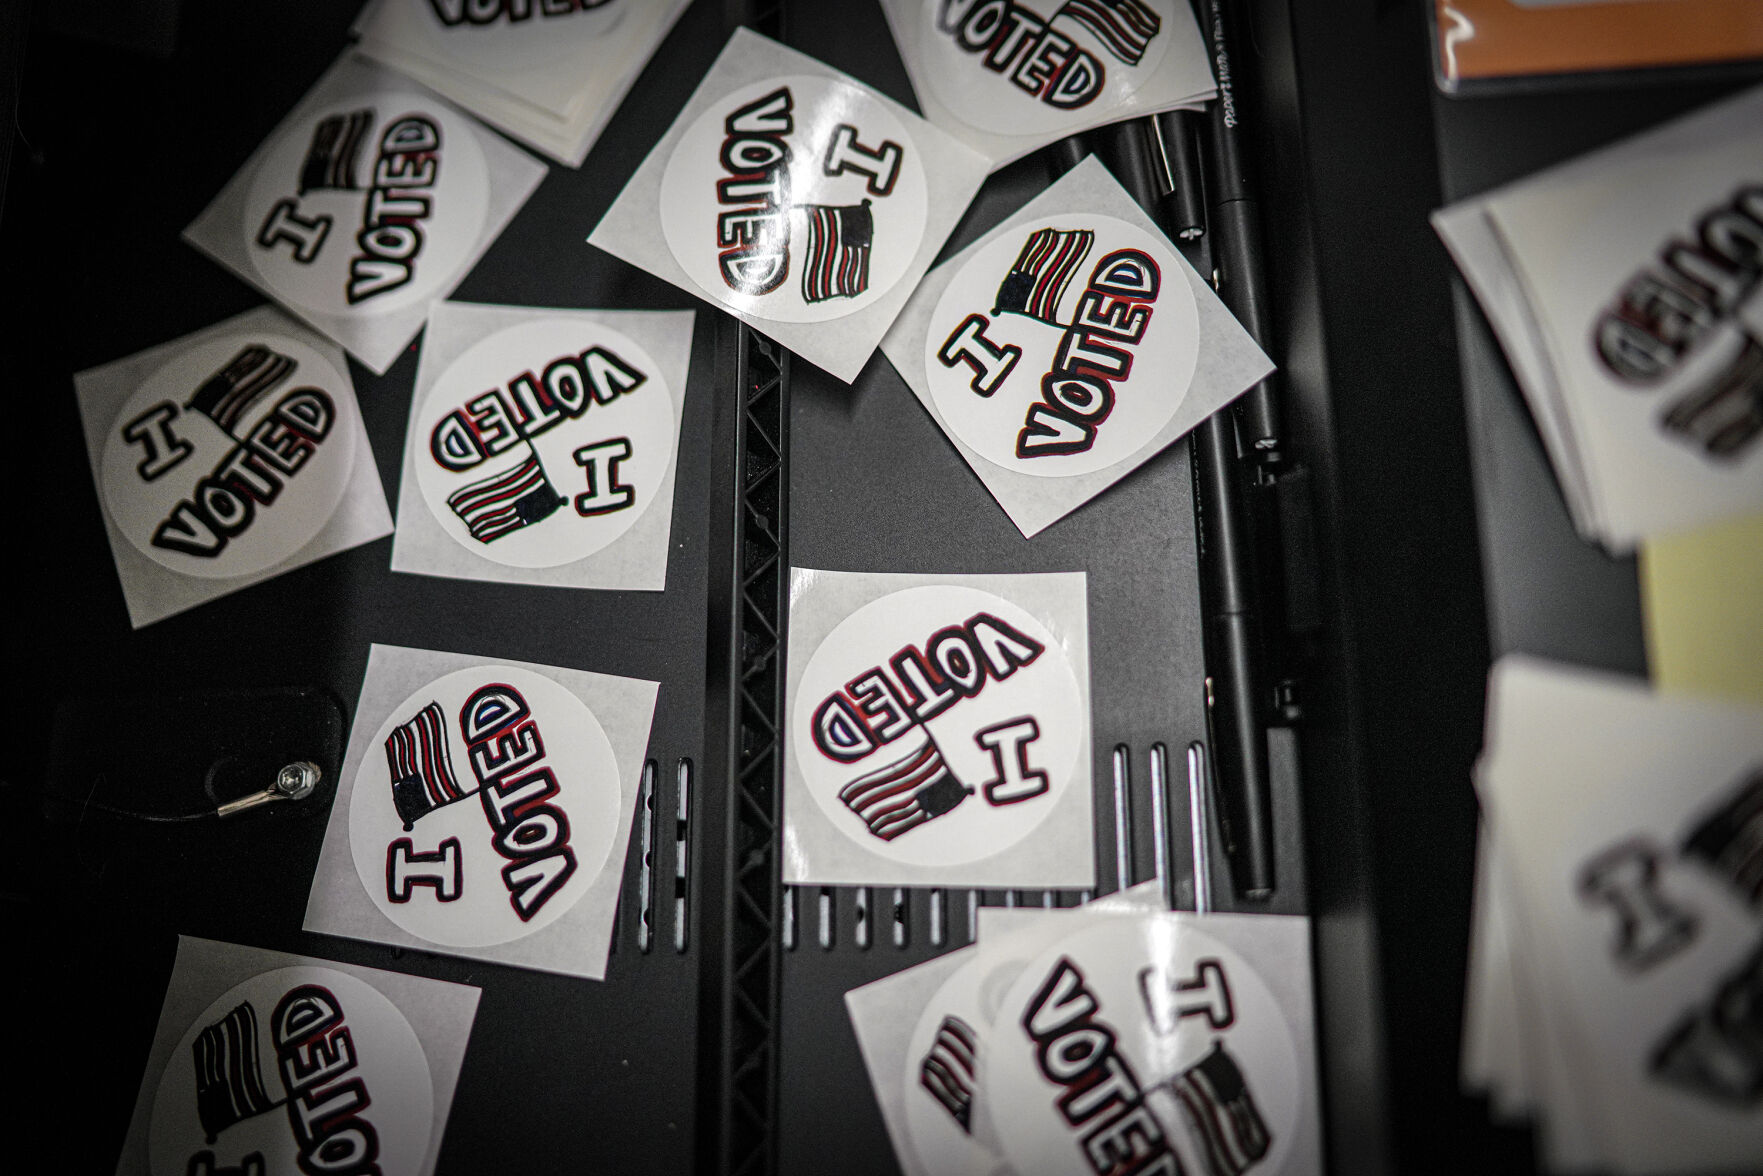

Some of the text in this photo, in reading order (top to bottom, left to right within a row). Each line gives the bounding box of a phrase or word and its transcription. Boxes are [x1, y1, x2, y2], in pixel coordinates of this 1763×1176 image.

[346, 114, 442, 305] VOTED
[716, 87, 793, 297] VOTED
[824, 124, 902, 197] I
[256, 198, 332, 264] I
[937, 313, 1022, 398] I
[1015, 249, 1163, 459] VOTED
[122, 400, 194, 482] I
[431, 346, 647, 472] VOTED
[151, 386, 336, 558] VOTED
[574, 437, 635, 517] I
[811, 612, 1045, 764] VOTED
[459, 683, 577, 922] VOTED
[975, 715, 1049, 807] I
[386, 837, 463, 903] I
[1138, 956, 1234, 1036] I
[271, 984, 388, 1176] OTED
